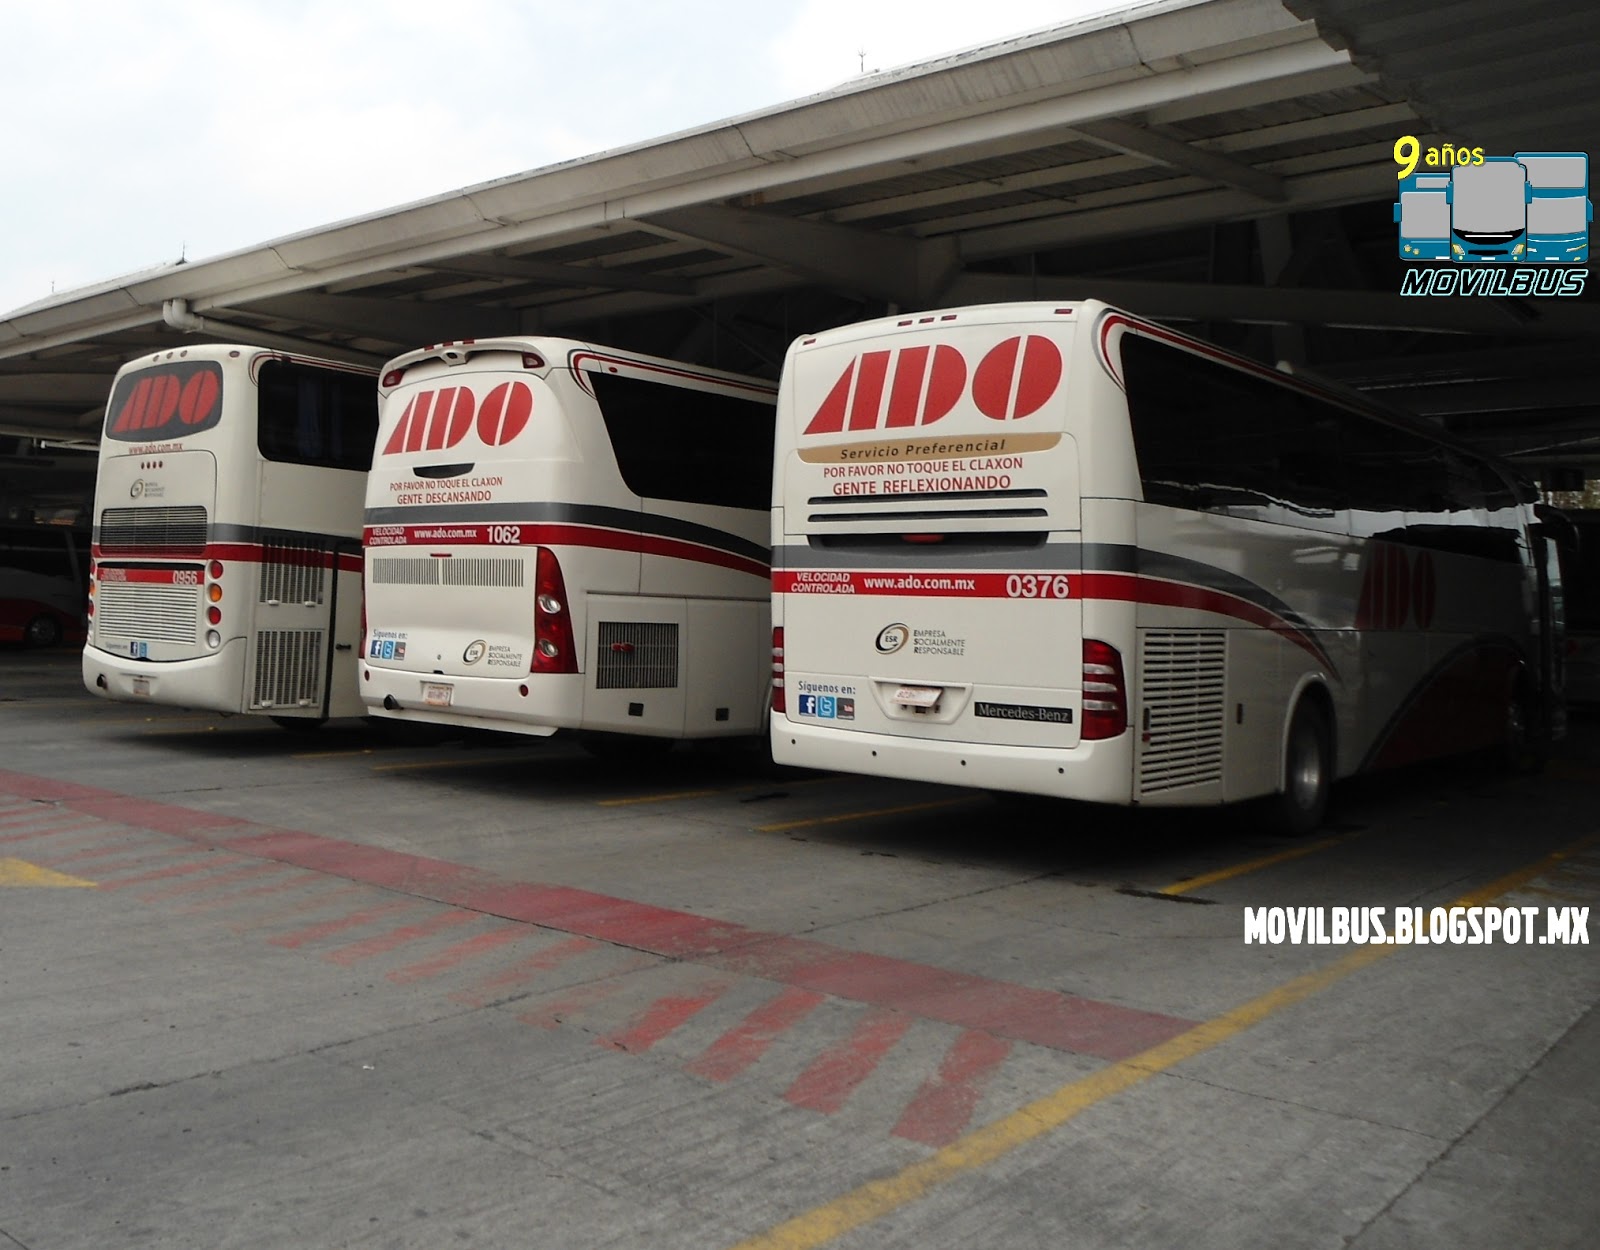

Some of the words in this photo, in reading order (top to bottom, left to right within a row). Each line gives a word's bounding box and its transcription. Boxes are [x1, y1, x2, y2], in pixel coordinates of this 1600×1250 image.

[803, 335, 1062, 435] ADO
[112, 369, 220, 433] ADO
[382, 380, 534, 456] ADO
[840, 445, 900, 460] Servicio
[906, 439, 1007, 456] Preferencial
[823, 467, 846, 478] POR
[848, 465, 885, 478] FAVOR
[887, 464, 905, 475] NO
[906, 461, 950, 475] TOQUE
[952, 460, 967, 472] EL
[969, 457, 1024, 471] CLAXON
[390, 482, 403, 491] POR
[403, 480, 425, 491] FAVOR
[425, 480, 437, 490] NO
[437, 478, 461, 490] TOQUE
[462, 478, 470, 487] EL
[471, 476, 503, 486] CLAXON
[832, 480, 877, 496] GENTE
[883, 475, 1012, 494] REFLEXIONANDO
[397, 493, 423, 505] GENTE
[426, 490, 492, 504] DESCANSANDO
[372, 527, 405, 536] VELOCIDAD
[414, 527, 477, 539] www.ado.com.mx
[487, 526, 521, 544] 1062
[369, 535, 407, 545] CONTROLADA
[172, 570, 198, 585] 0956
[796, 572, 850, 583] VELOCIDAD
[863, 575, 976, 591] www.ado.com.mx
[791, 582, 856, 594] CONTROLADA
[1006, 574, 1070, 599] 0376
[1355, 542, 1437, 631] ADO
[913, 630, 946, 638] EMPRESA
[913, 638, 966, 648] SOCIALMENTE
[913, 647, 965, 656] RESPONSABLE
[841, 686, 856, 695] en:
[977, 703, 1070, 723] Mercedes-Benz
